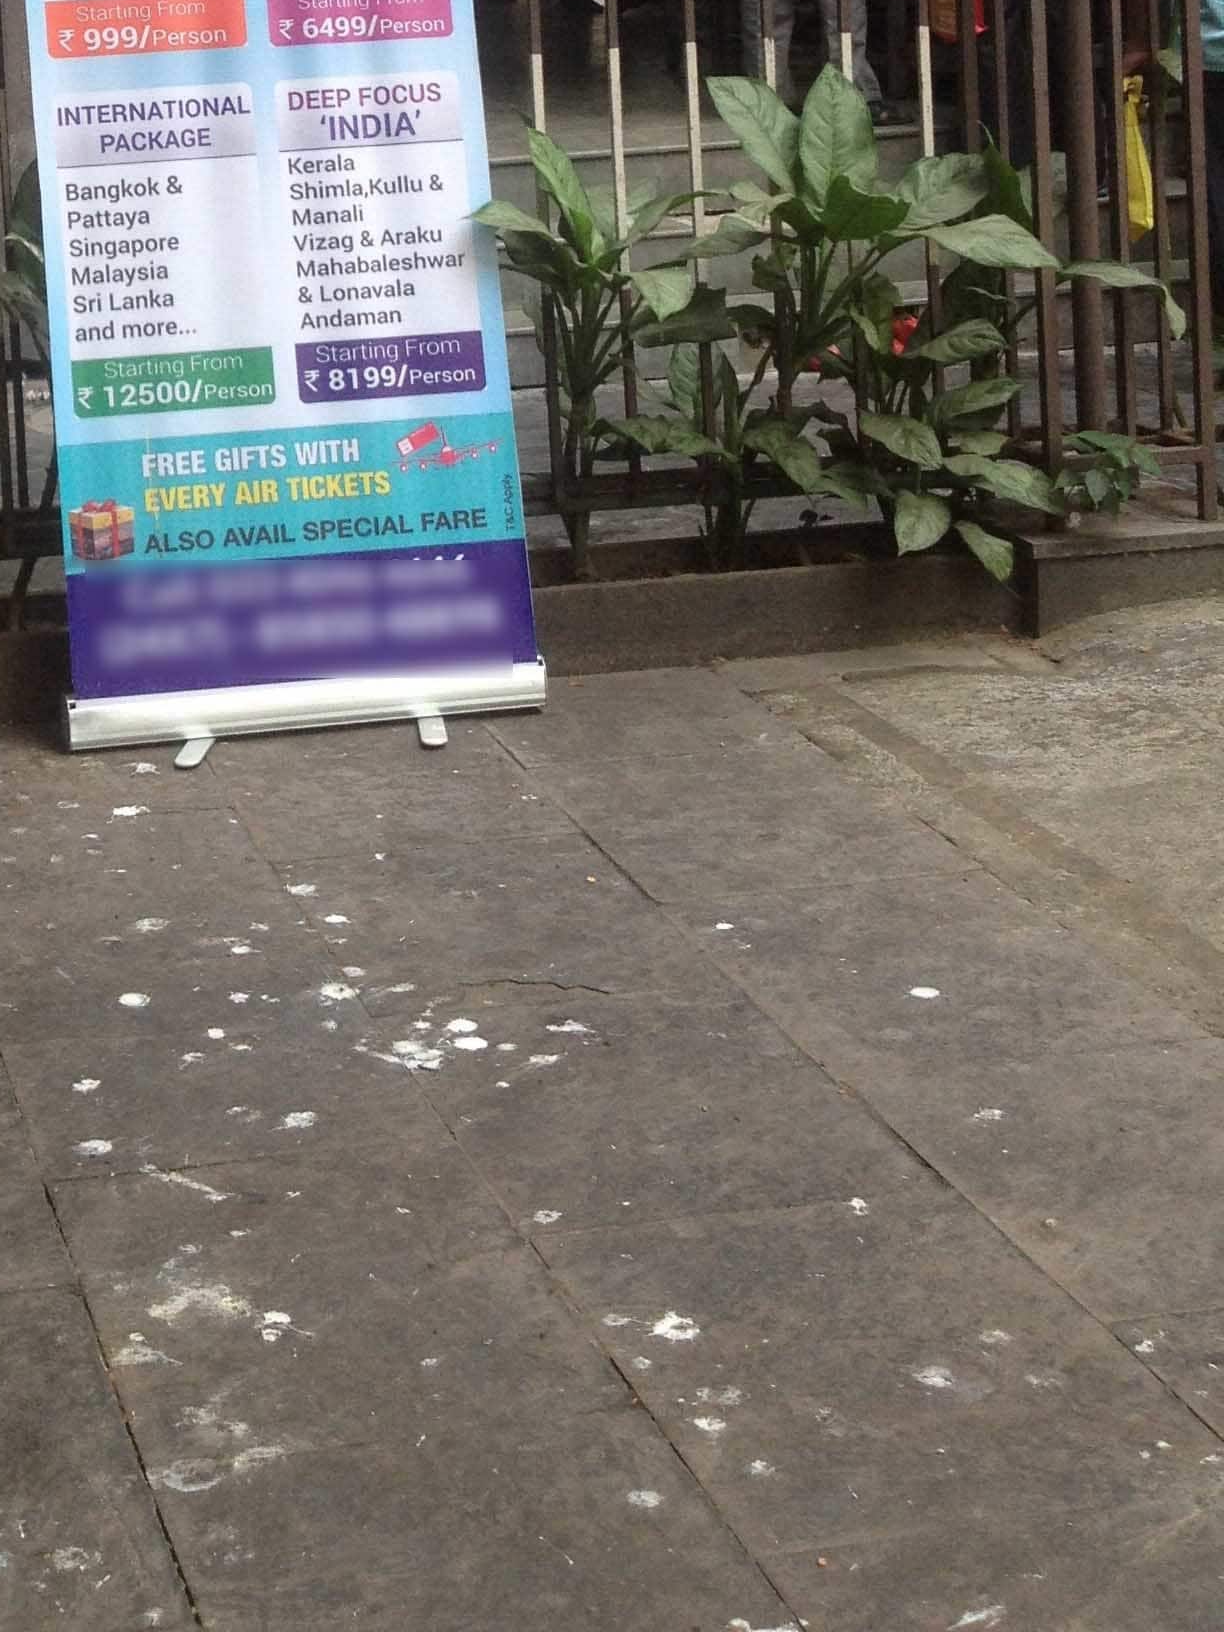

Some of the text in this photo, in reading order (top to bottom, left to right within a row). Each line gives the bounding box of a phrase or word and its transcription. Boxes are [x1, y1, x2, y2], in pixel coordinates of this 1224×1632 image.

[76, 3, 152, 24] Starting
[287, 82, 442, 112] DEEP FOCUS
[57, 95, 251, 127] INTERNATIONAL
[100, 128, 212, 154] PACKAGE
[287, 156, 355, 175] Kerala
[65, 175, 184, 203] Bangkok &
[429, 174, 444, 192] &
[66, 207, 152, 233] Pattaya
[291, 203, 364, 227] Manali
[69, 235, 181, 261] Singapore
[293, 225, 443, 253] Vizag & Araku
[71, 261, 169, 286] Malaysia
[295, 251, 466, 279] Mahabaleshwar
[73, 291, 175, 314] Sri Lanka
[298, 280, 416, 304] & Lonavala
[75, 320, 116, 342] and
[300, 307, 403, 330] Andaman
[316, 337, 462, 364] Starting From
[104, 353, 243, 379] Starting From
[141, 438, 360, 479] FREE GIFTS WITH
[144, 470, 391, 513] EVERY AIR TICKETS
[144, 507, 488, 555] ALSO AVAIL SPECIAL FARE
